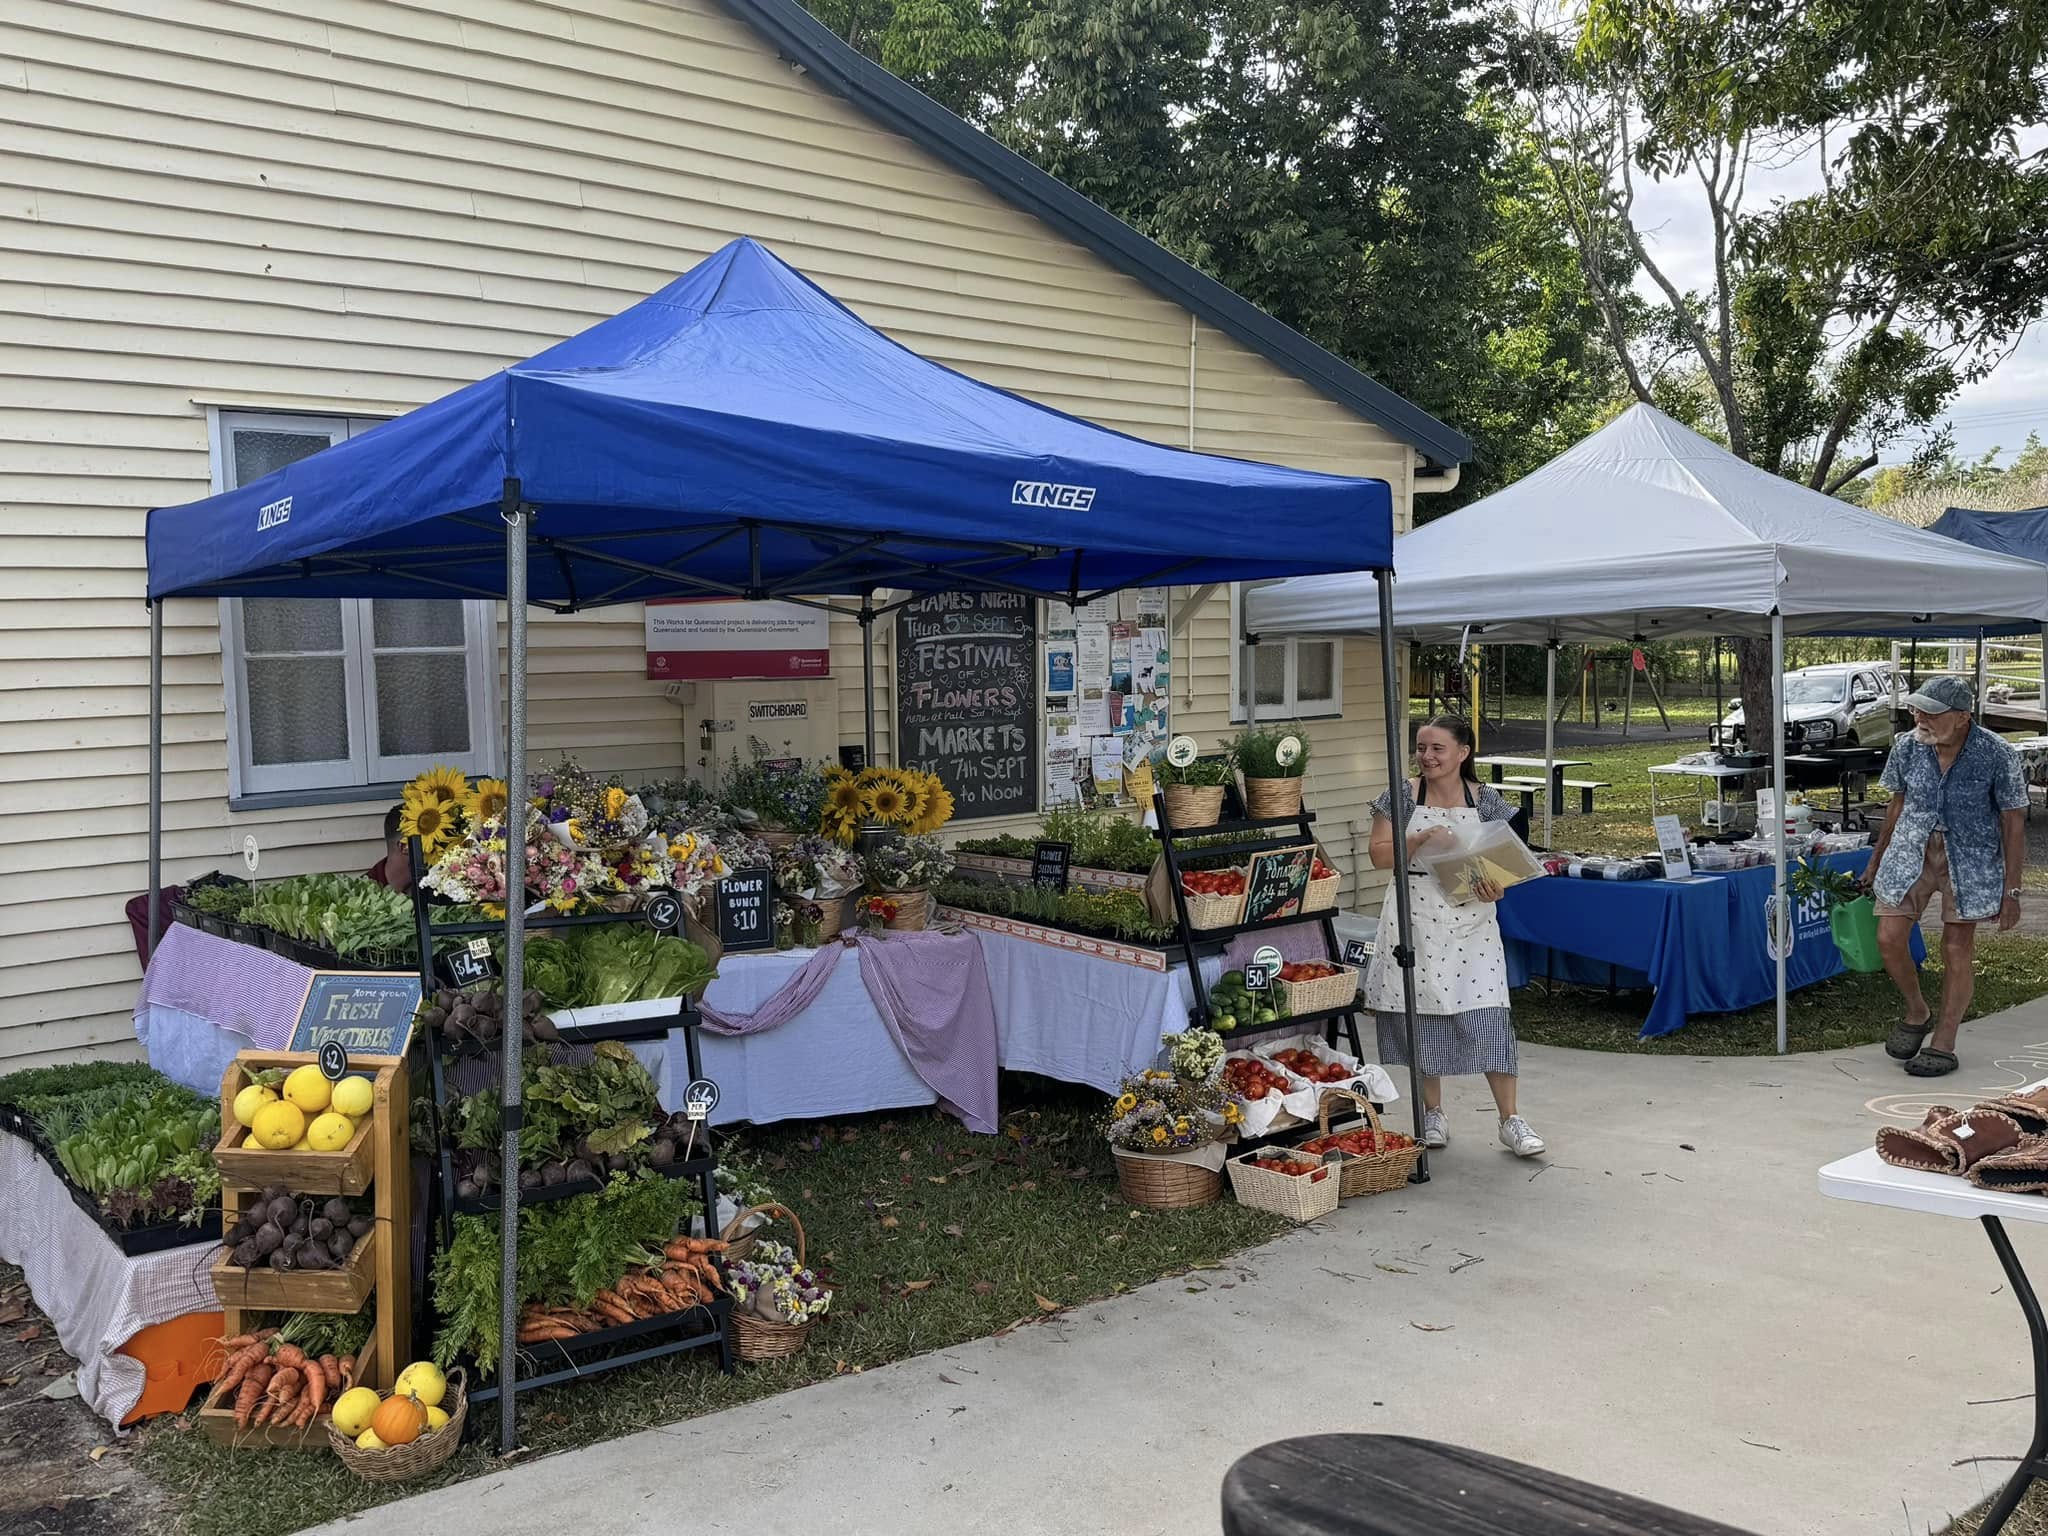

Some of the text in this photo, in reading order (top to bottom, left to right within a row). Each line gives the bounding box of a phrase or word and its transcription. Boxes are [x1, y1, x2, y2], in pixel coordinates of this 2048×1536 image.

[1012, 480, 1096, 511] KINGS
[257, 496, 293, 532] KINGS
[981, 592, 1026, 609] NIGHT
[653, 618, 665, 626] This
[666, 618, 684, 626] Works
[694, 618, 726, 626] Queensland
[727, 618, 745, 627] project
[751, 618, 776, 627] delivering
[776, 618, 787, 627] jobs
[796, 618, 816, 627] regional
[653, 626, 687, 634] Queensland
[688, 626, 698, 634] and
[699, 626, 718, 634] funded
[727, 626, 735, 634] the
[736, 626, 767, 634] Queensland
[904, 616, 941, 638] THUR
[943, 613, 969, 633] 5th
[915, 643, 1022, 673] FESTIVAL
[957, 670, 976, 680] OF
[911, 681, 1017, 709] FLOWERS
[749, 702, 807, 719] SWITCHBOARD
[905, 711, 929, 724] here
[918, 724, 1026, 756] MARKETS
[981, 756, 1026, 780] SEPT
[960, 784, 1023, 802] to NOON
[721, 879, 763, 894] FLOWER
[729, 897, 760, 908] BUNCH
[653, 902, 675, 924] $2
[733, 909, 757, 930] $10
[1349, 946, 1366, 963] $4
[455, 954, 483, 977] $4
[380, 990, 408, 1001] grown
[324, 994, 385, 1021] FRESH
[310, 1026, 396, 1048] VEGETABLES
[326, 1050, 340, 1069] $2
[691, 1086, 714, 1106] $4
